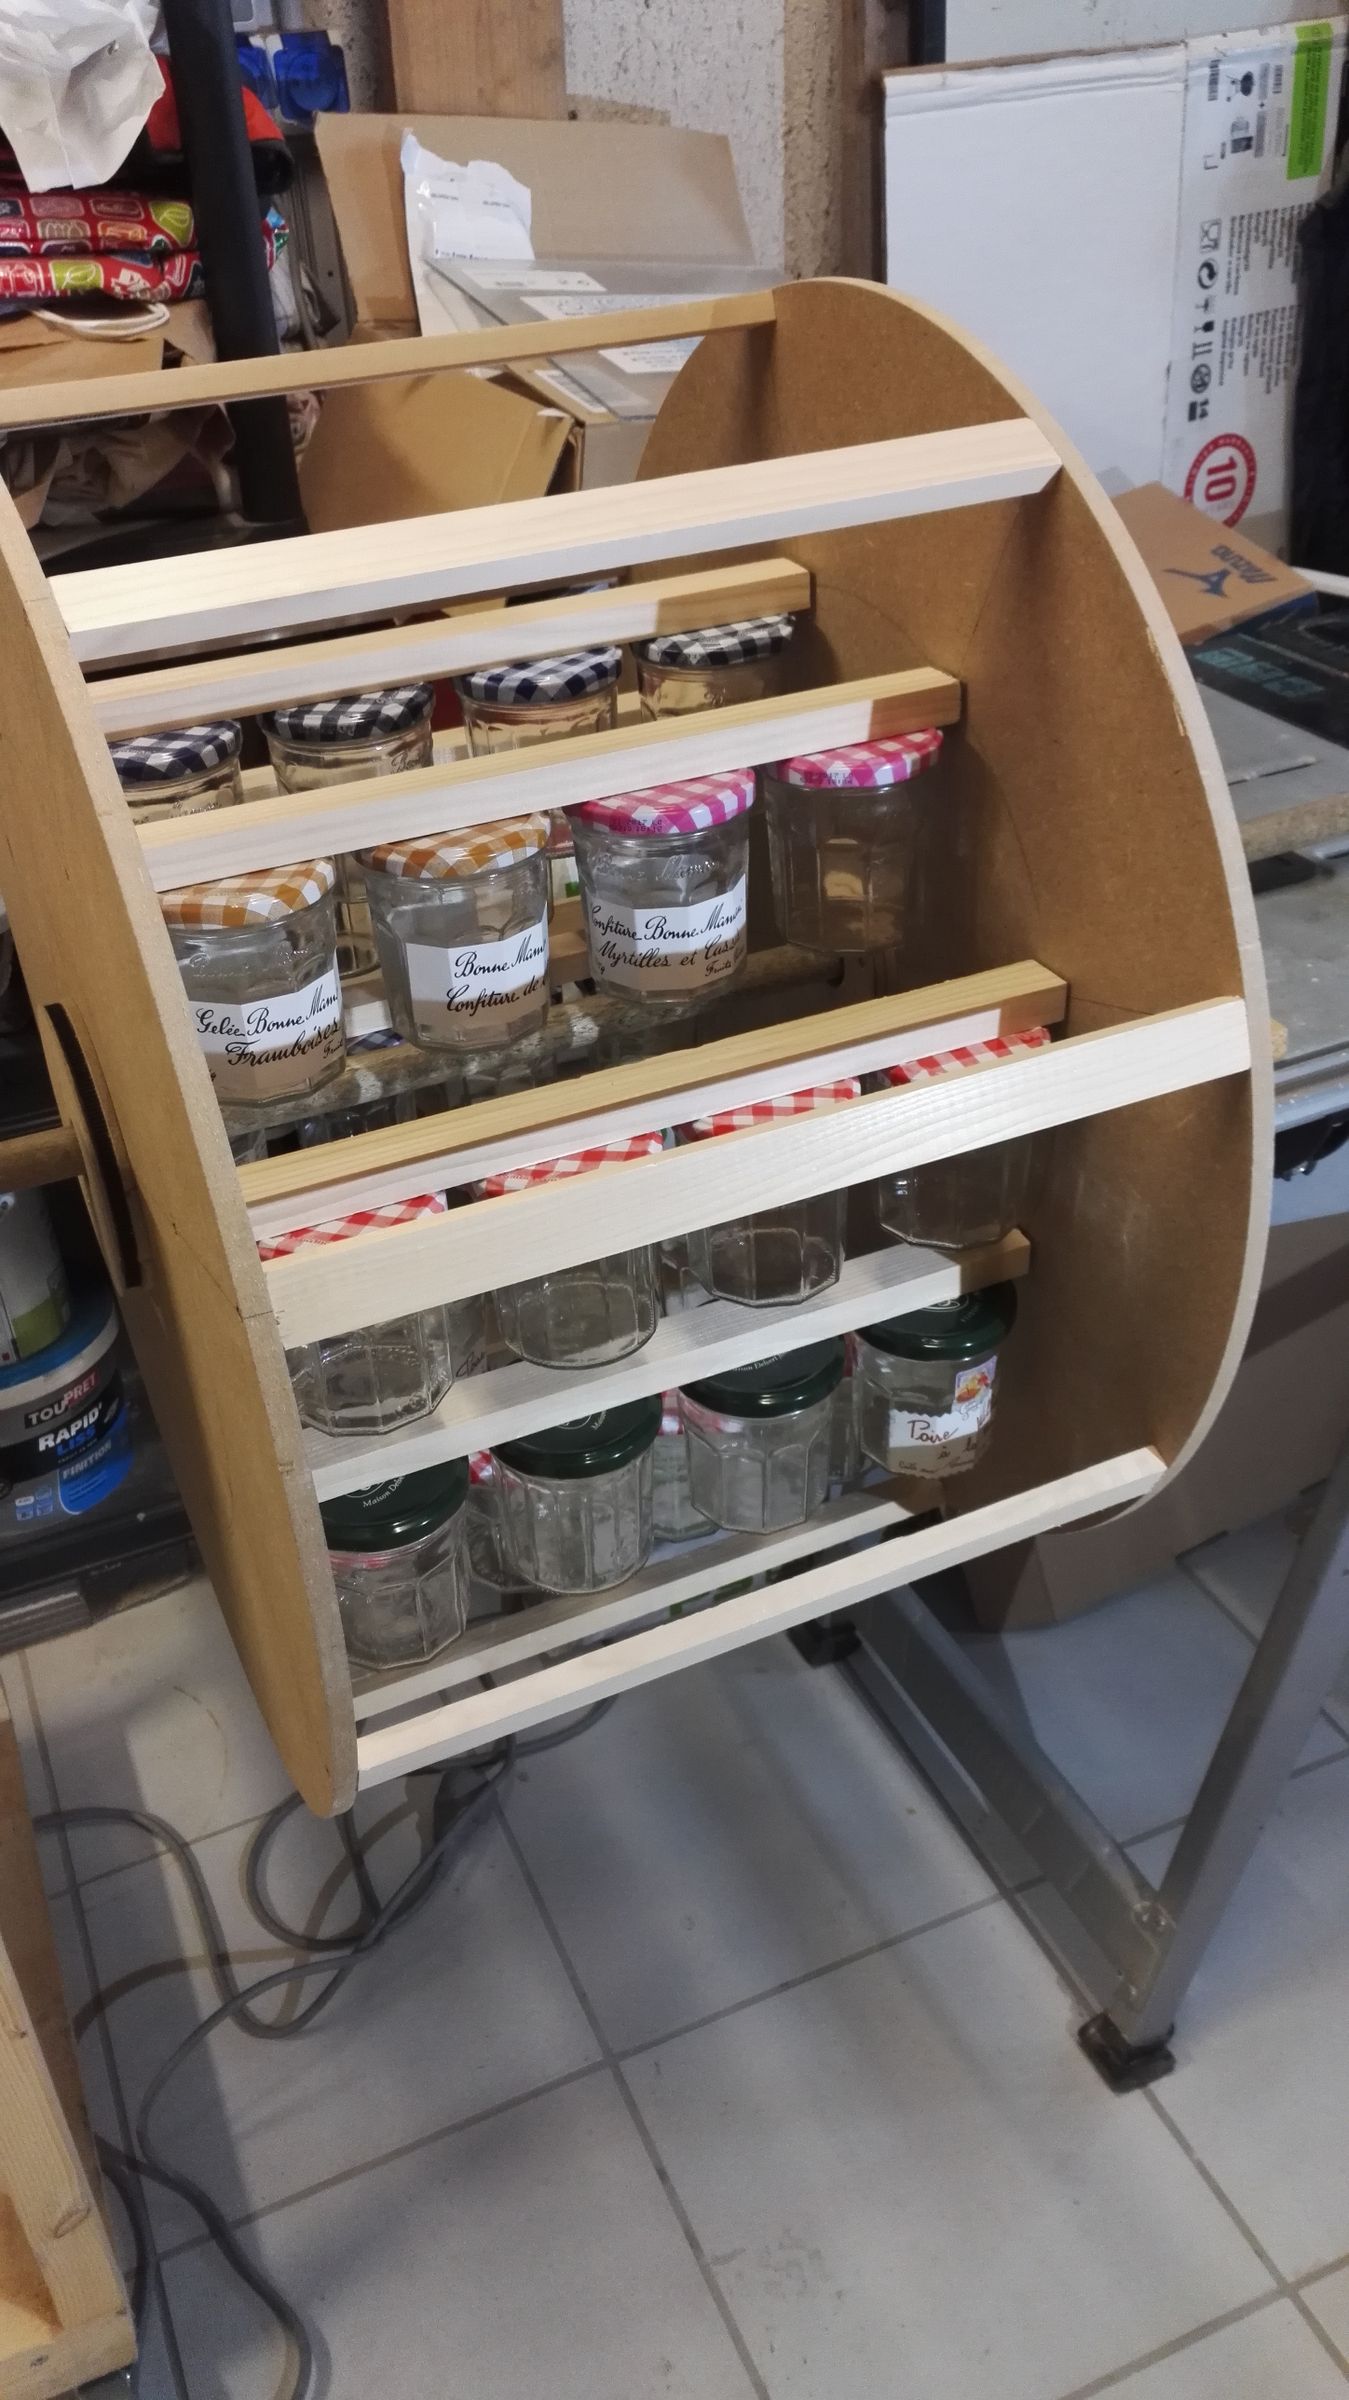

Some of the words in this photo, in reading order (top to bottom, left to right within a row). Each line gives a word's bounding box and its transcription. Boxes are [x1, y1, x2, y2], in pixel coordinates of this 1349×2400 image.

[1205, 456, 1238, 502] 10
[591, 905, 643, 941] Confiture
[643, 916, 700, 940] Bonne
[454, 951, 511, 979] Bonne
[598, 940, 671, 968] Myrtilles
[680, 953, 696, 966] et
[446, 984, 520, 1017] Confiture
[523, 975, 541, 997] de
[195, 1007, 246, 1037] Gelée
[246, 1006, 305, 1036] Bonne
[224, 1016, 340, 1068] Framboises
[28, 1373, 97, 1426] TOUPRET
[907, 1419, 960, 1444] Poire
[62, 1438, 113, 1480] FINITION
[362, 1490, 391, 1508] Maison
